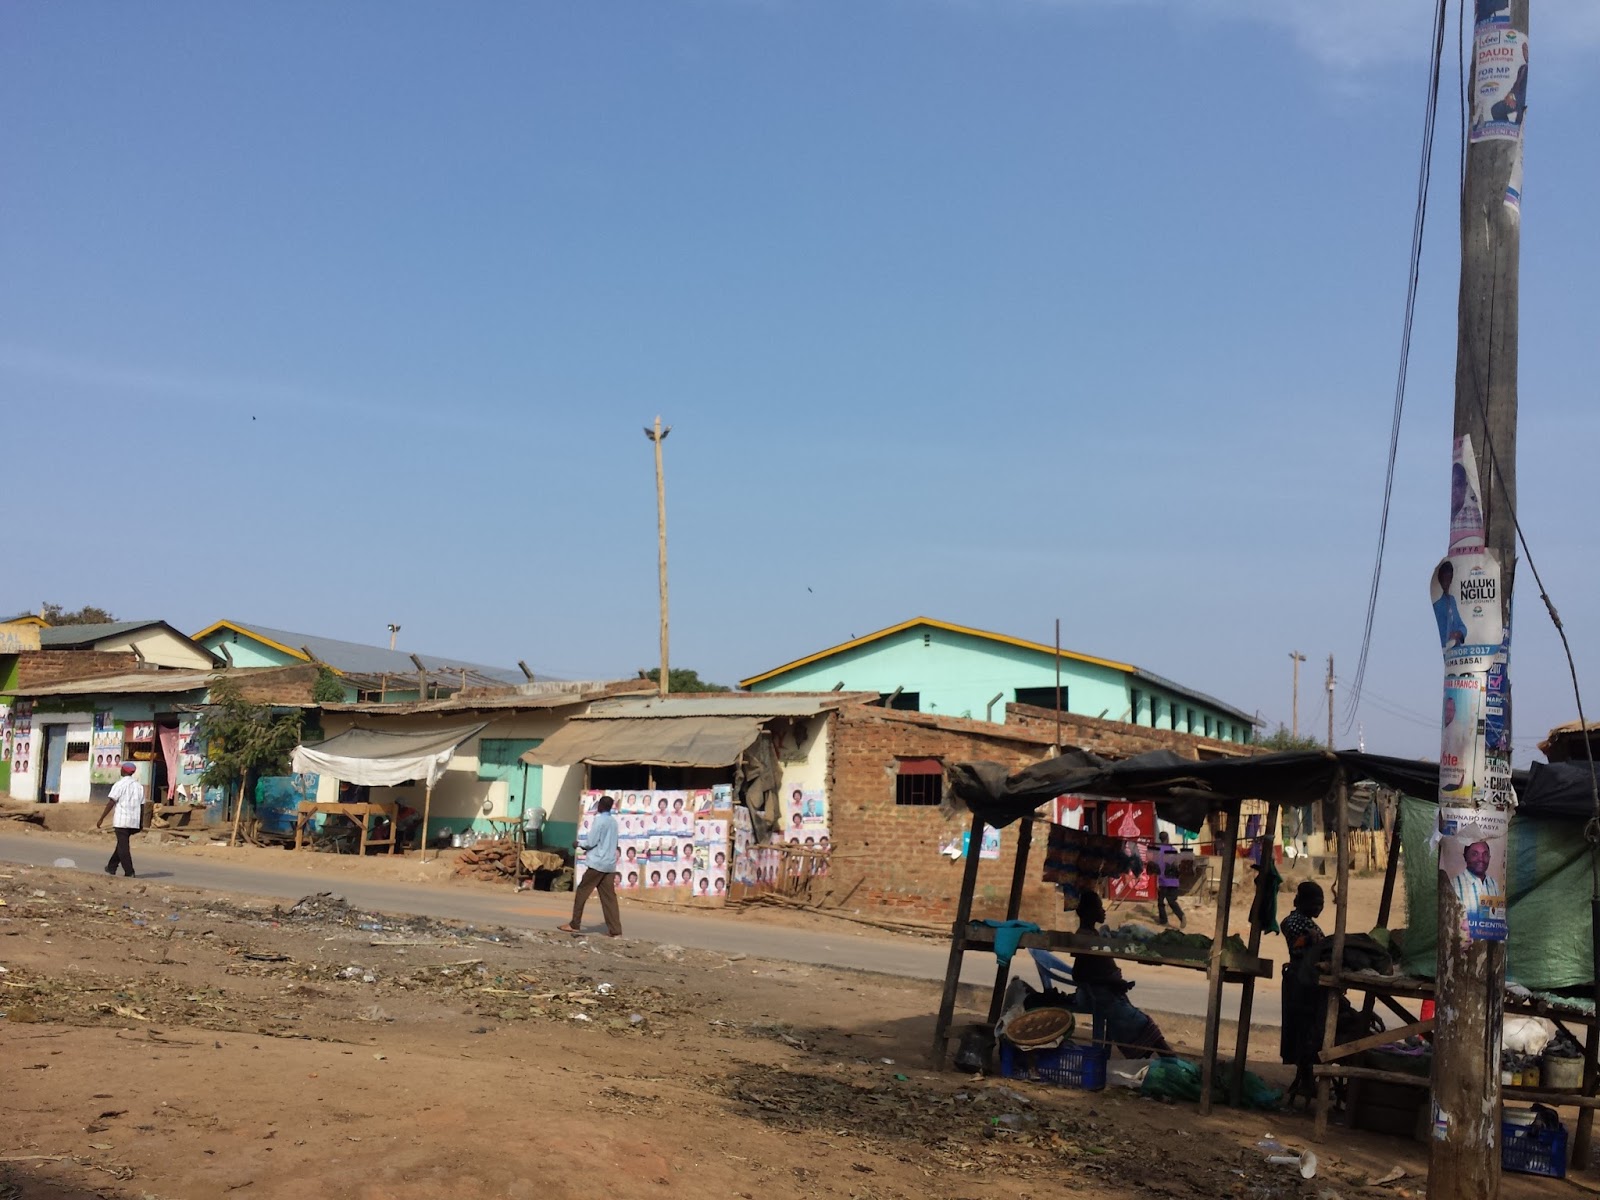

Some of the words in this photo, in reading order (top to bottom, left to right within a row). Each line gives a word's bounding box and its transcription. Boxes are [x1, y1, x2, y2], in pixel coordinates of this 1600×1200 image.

[1479, 48, 1514, 59] DAUDI
[1478, 67, 1494, 76] FOR
[1496, 66, 1510, 74] MP
[1460, 579, 1495, 590] KALUKI
[1460, 589, 1496, 601] NGILU
[1470, 646, 1491, 655] 2017
[1459, 657, 1483, 666] SASA!
[1454, 680, 1479, 690] FRANCIS
[1446, 814, 1479, 822] BERNARD
